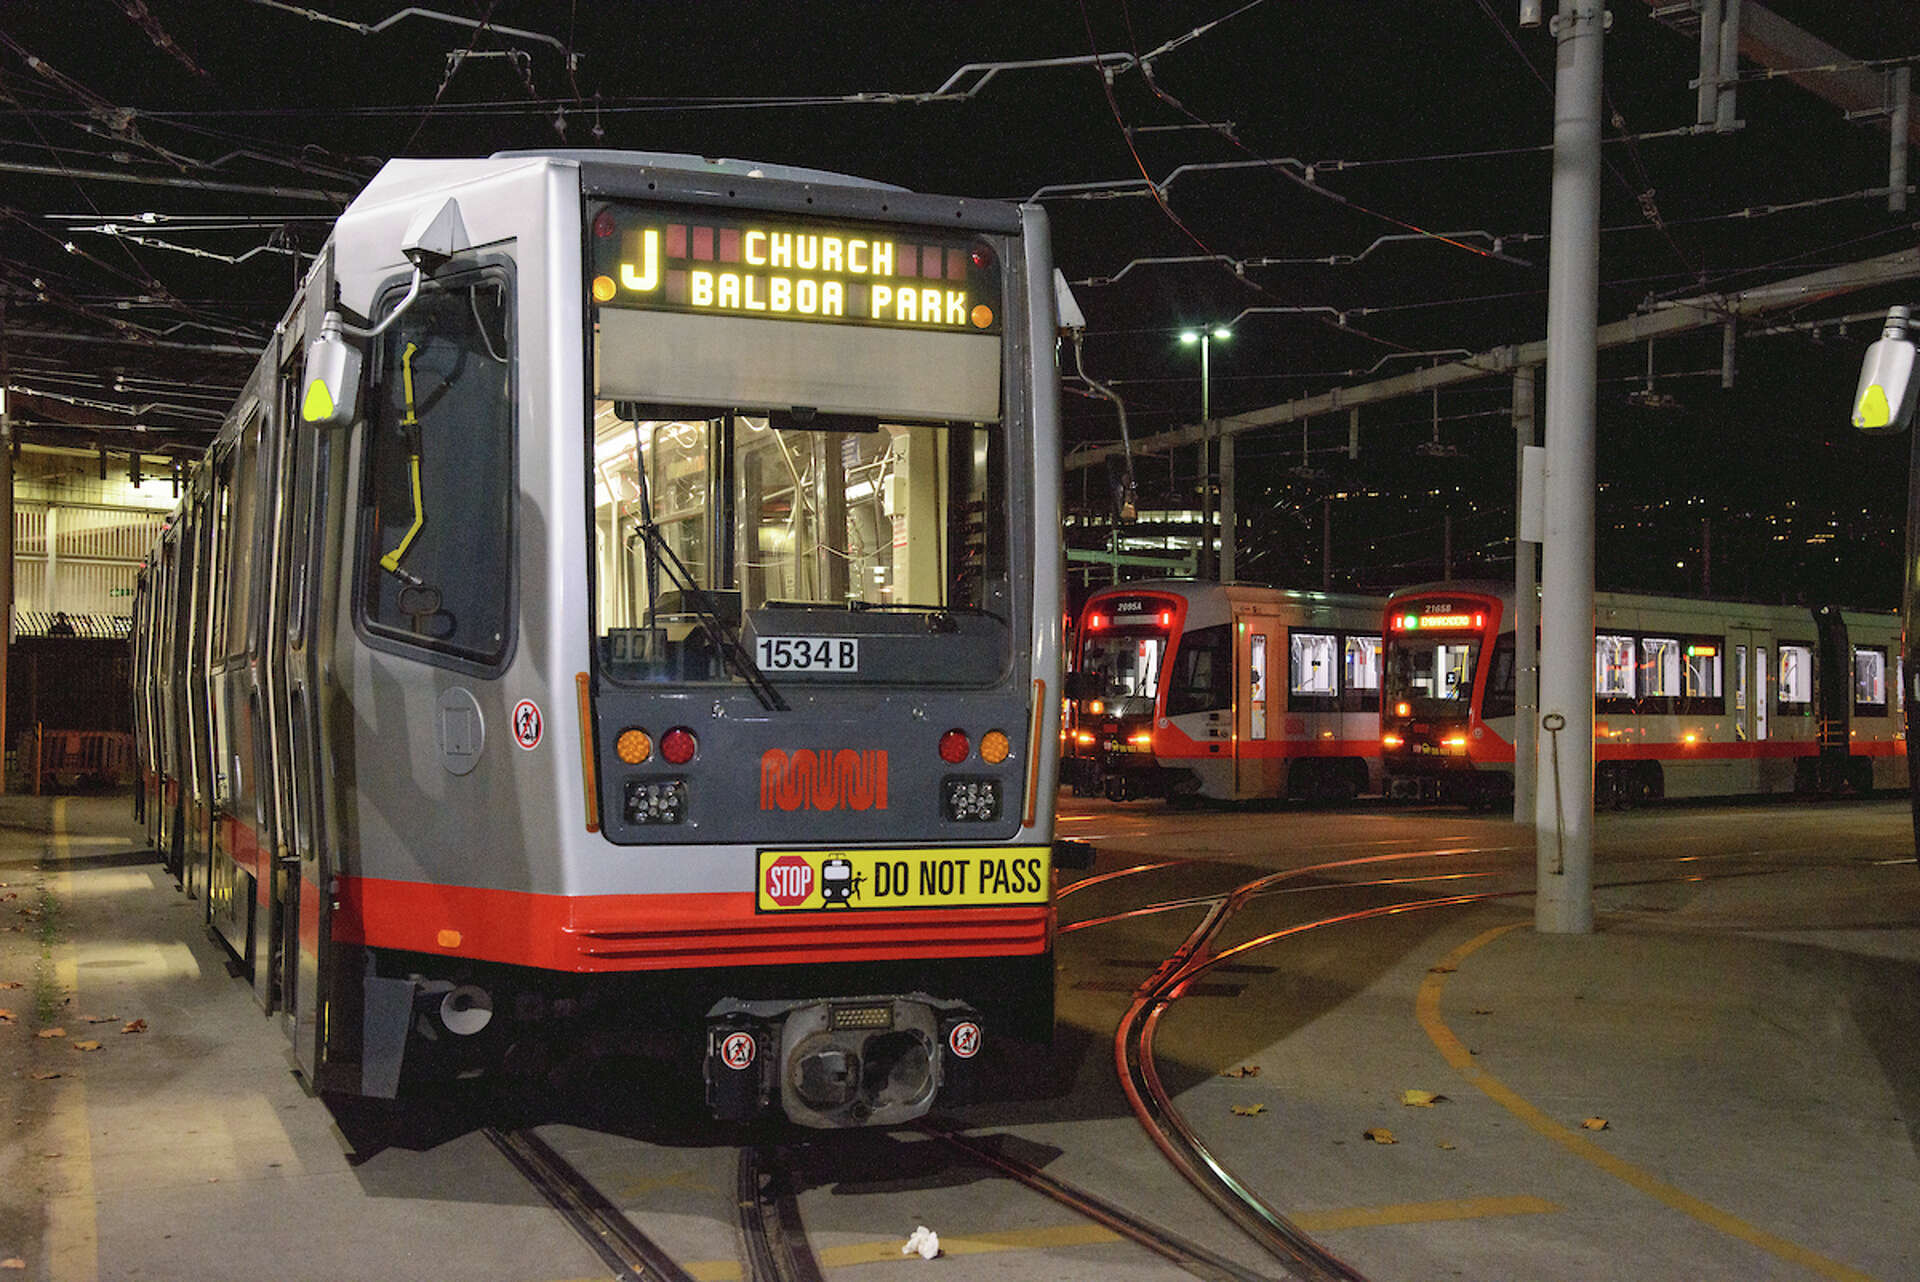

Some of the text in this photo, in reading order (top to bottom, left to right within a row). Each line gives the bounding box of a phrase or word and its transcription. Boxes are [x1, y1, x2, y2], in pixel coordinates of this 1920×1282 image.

[621, 230, 658, 291] J
[745, 231, 893, 276] CHURCH
[691, 271, 966, 325] BALBOA PARK
[760, 639, 832, 669] 1534
[770, 865, 811, 897] STOP
[875, 858, 1041, 897] DO NOT PASS
